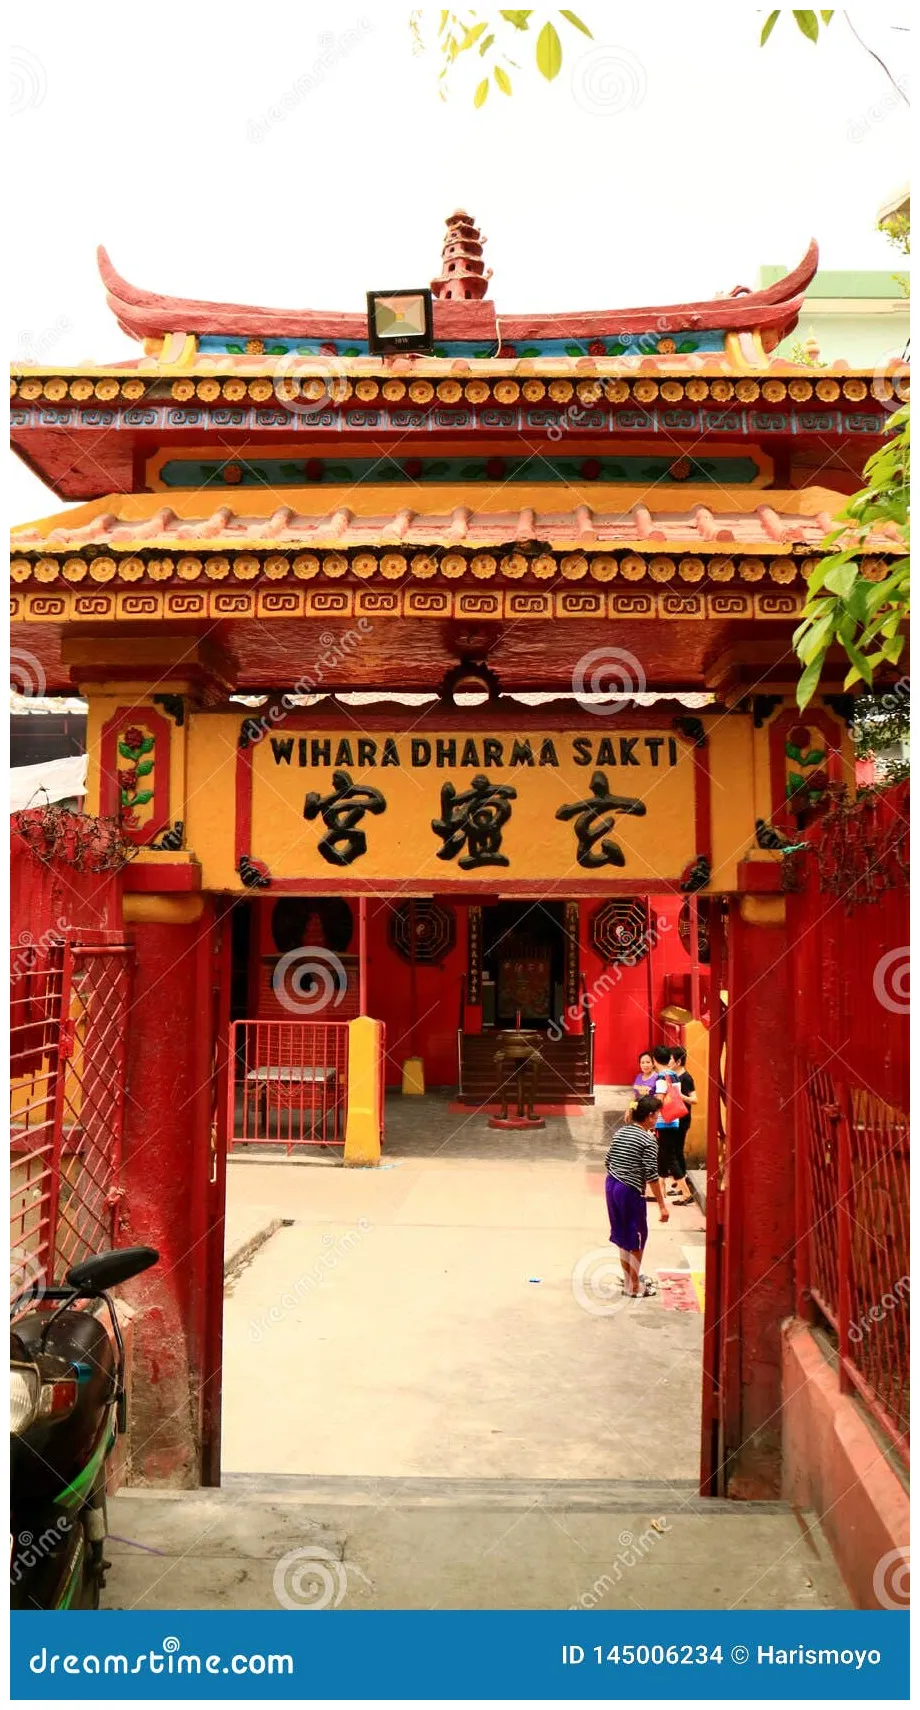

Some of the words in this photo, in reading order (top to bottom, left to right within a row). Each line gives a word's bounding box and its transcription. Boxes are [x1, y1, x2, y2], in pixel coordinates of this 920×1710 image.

[269, 737, 401, 767] WIHARA
[411, 737, 560, 768] DHARMA
[572, 736, 678, 767] SAKTI
